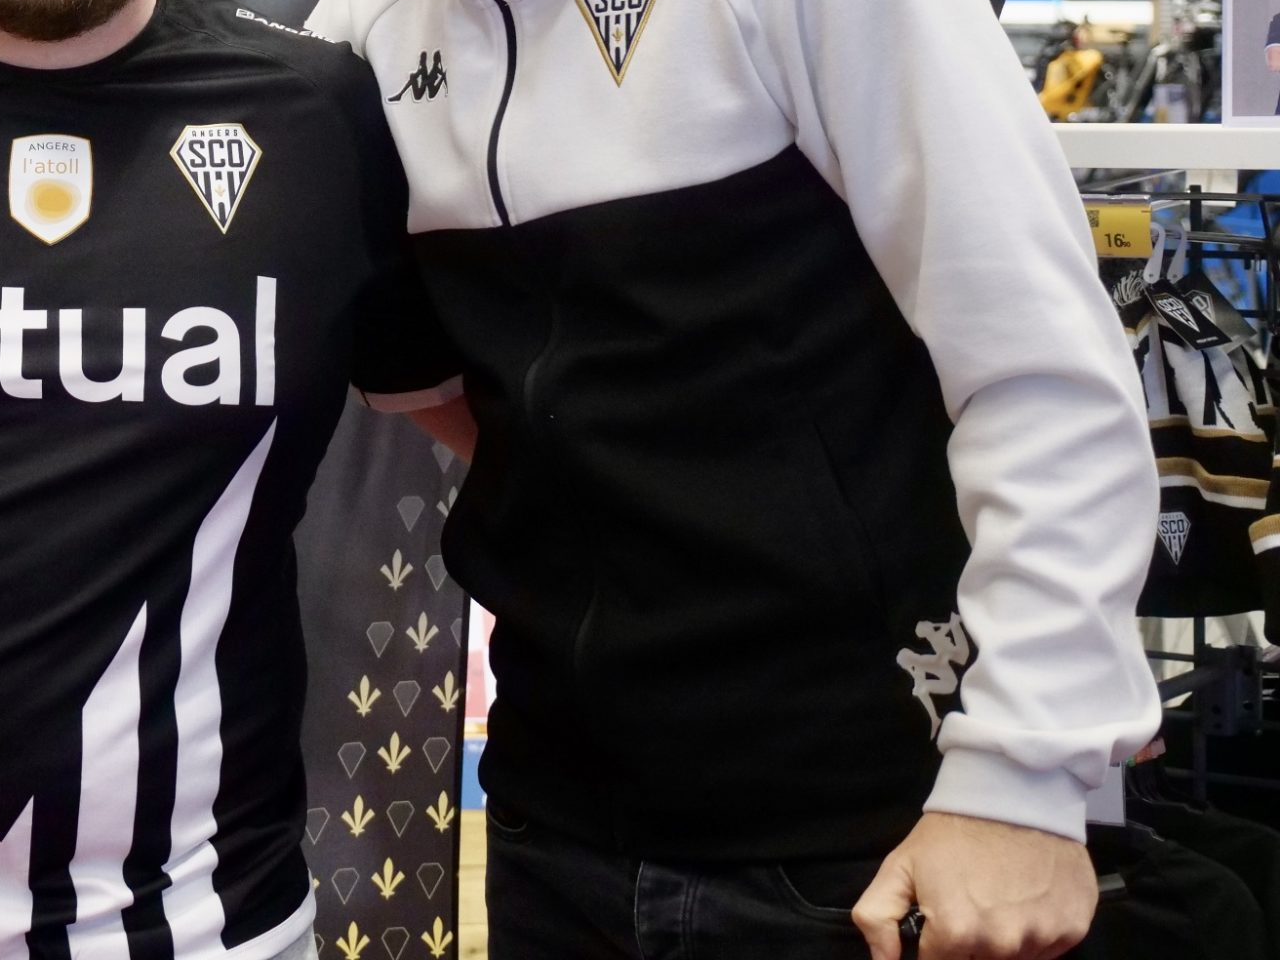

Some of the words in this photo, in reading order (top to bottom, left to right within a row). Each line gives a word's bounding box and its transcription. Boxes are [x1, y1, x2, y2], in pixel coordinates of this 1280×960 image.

[192, 128, 238, 137] ANGERS
[28, 141, 77, 152] ANGERS
[188, 139, 245, 168] SCO
[23, 157, 79, 174] l'atoll
[1161, 519, 1185, 534] SCO
